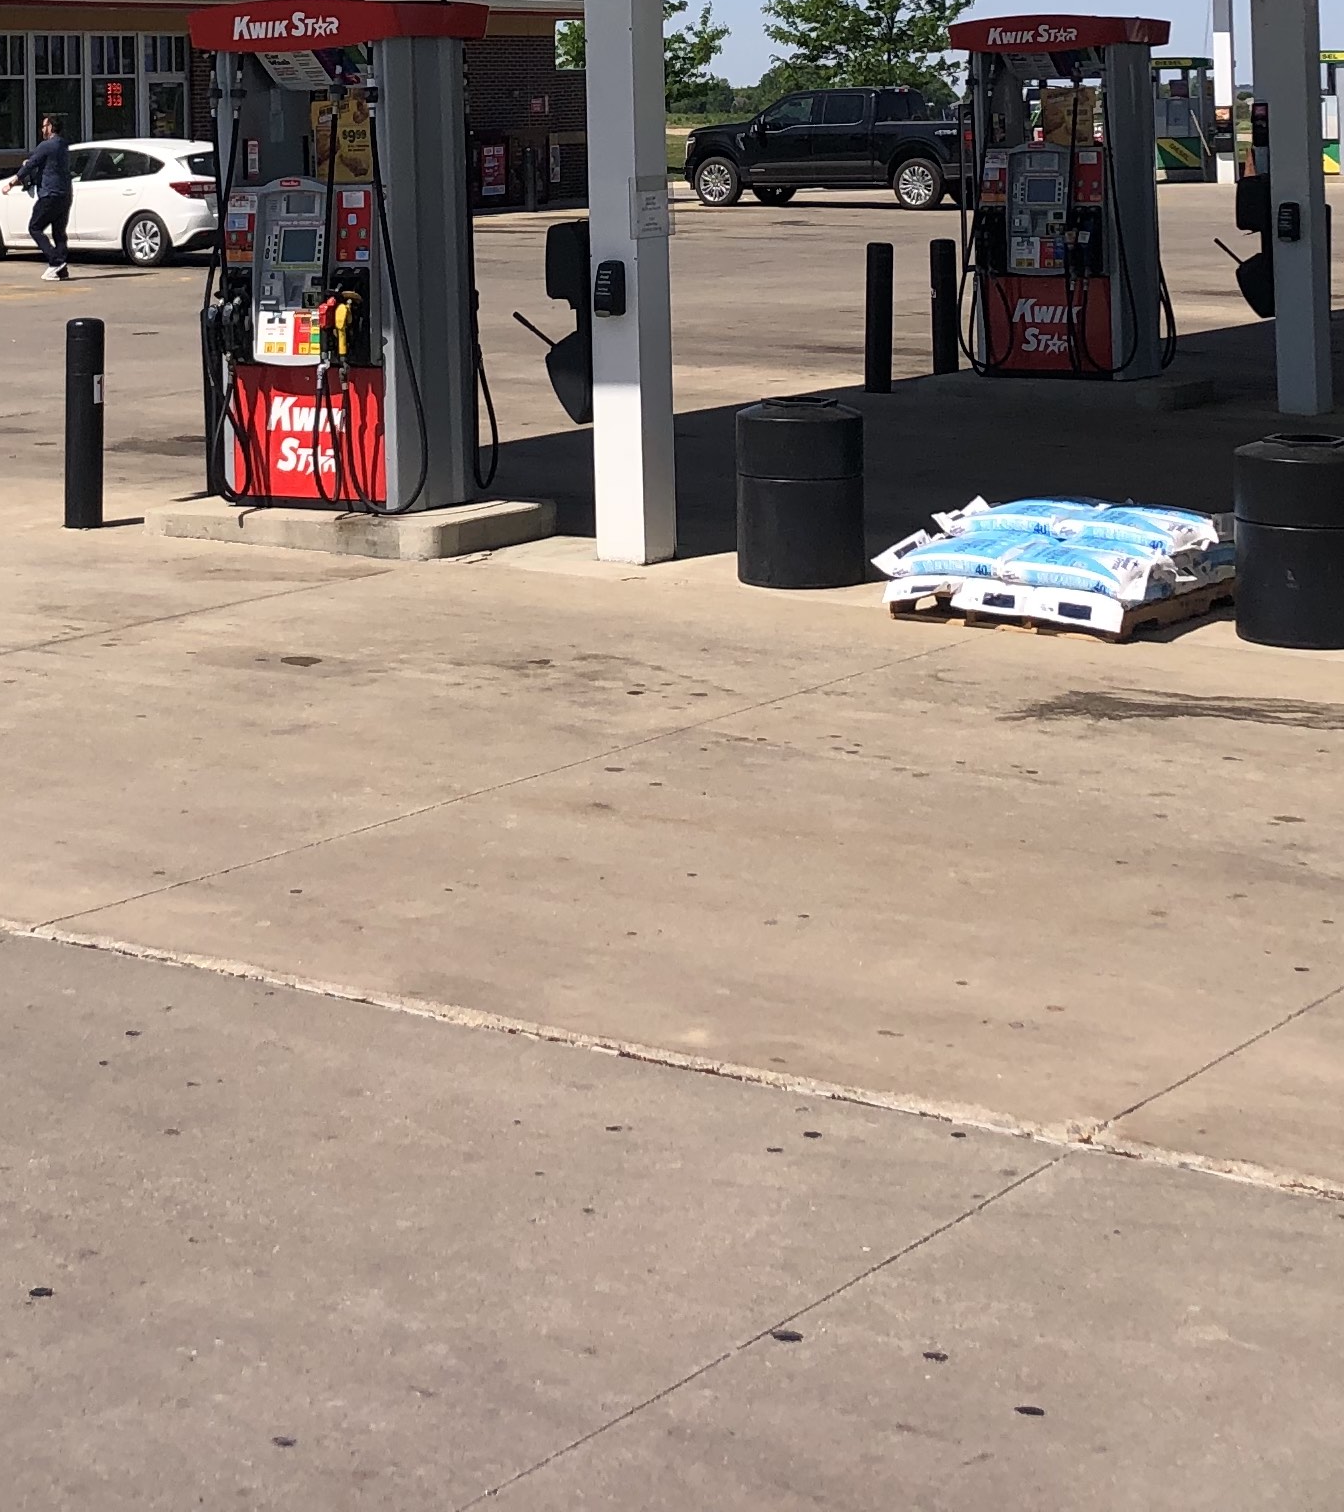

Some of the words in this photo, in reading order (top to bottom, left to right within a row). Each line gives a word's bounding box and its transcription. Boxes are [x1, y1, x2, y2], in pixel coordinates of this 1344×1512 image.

[233, 15, 289, 40] KWIK
[291, 11, 339, 38] STAR
[987, 27, 1036, 45] KWIK
[1037, 24, 1078, 43] STAR
